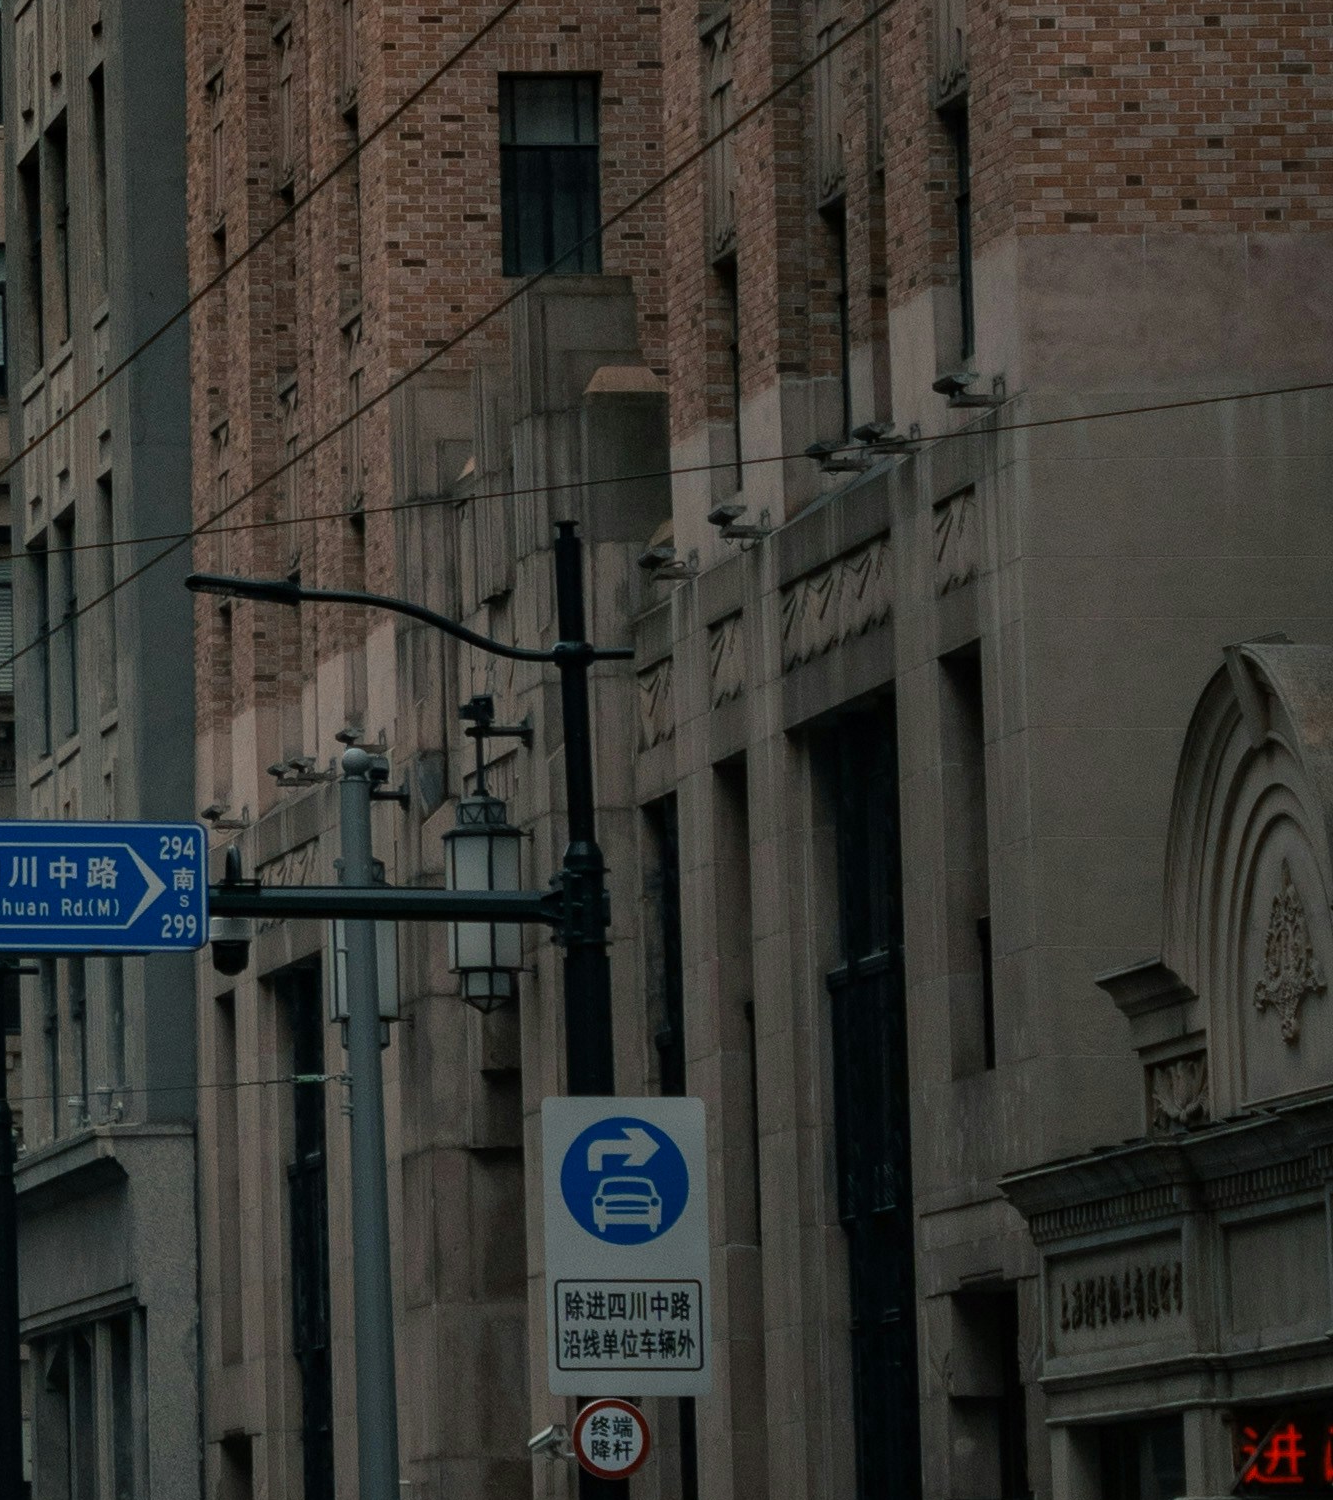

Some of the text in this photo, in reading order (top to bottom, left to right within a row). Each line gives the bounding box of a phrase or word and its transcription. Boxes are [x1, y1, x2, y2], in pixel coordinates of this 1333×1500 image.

[159, 836, 195, 861] 294
[173, 867, 195, 891] 南
[62, 897, 120, 918] Rd.(M)
[179, 894, 190, 908] S
[161, 914, 197, 939] 299
[564, 1290, 691, 1321] 除进四川中路
[564, 1328, 695, 1361] 沿线单位车辆外
[590, 1415, 633, 1438] 终端
[590, 1439, 634, 1461] 降杆
[1240, 1421, 1333, 1484] 进
